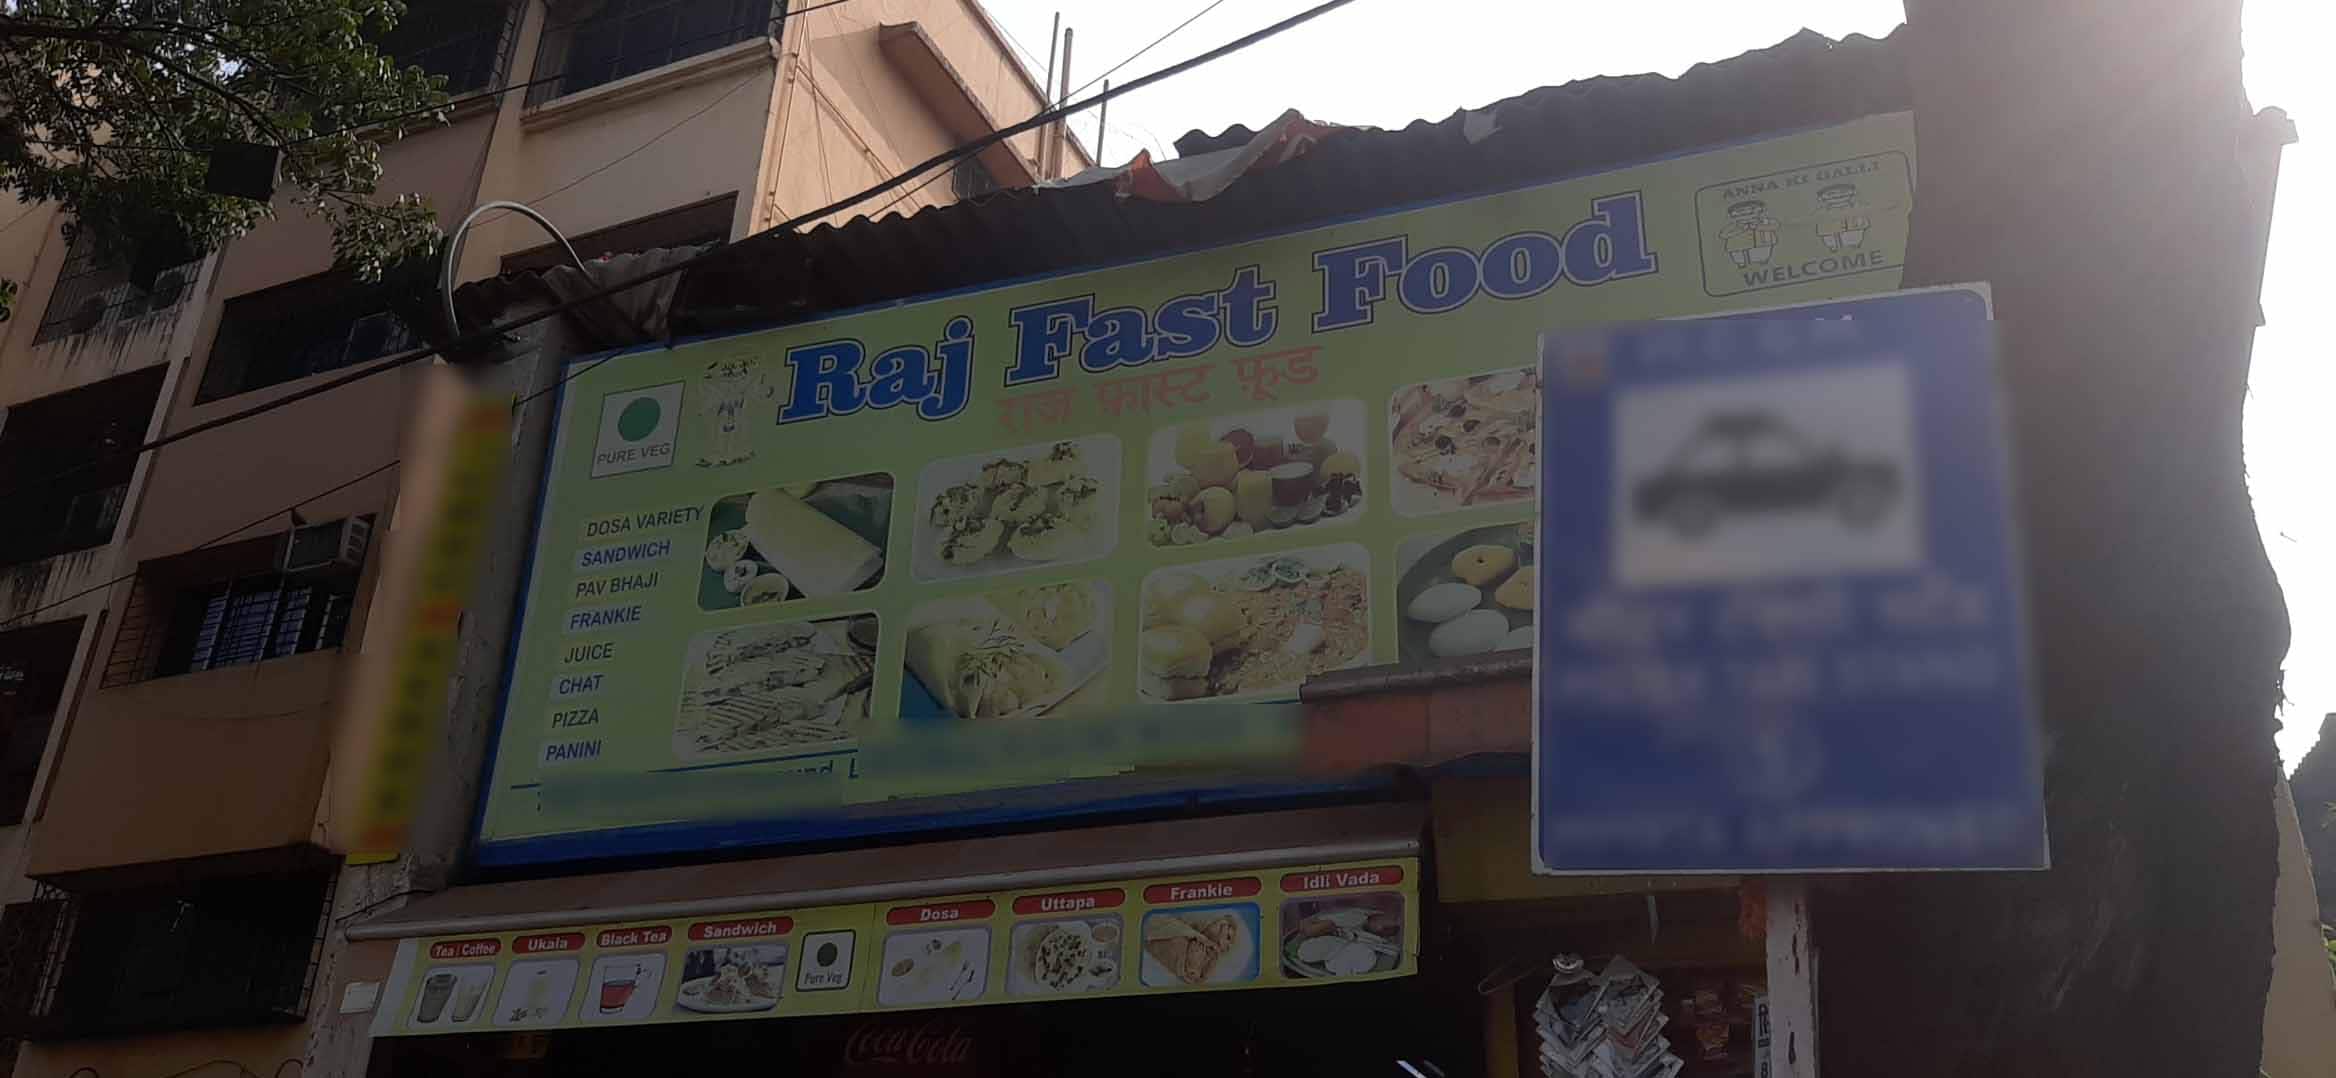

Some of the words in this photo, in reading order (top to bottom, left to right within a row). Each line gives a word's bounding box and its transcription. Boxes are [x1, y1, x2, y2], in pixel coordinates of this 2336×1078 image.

[1743, 250, 1885, 287] WELCOME
[778, 317, 975, 424] Raj
[1004, 265, 1278, 389] Fast
[1311, 190, 1659, 334] Food
[596, 448, 637, 466] PURE
[638, 442, 672, 460] VEG
[586, 518, 632, 538] DOSA
[636, 505, 706, 530] VARIETY
[580, 540, 672, 567] SANDWICH
[575, 580, 606, 599] PAV
[609, 571, 659, 594] BHAJI
[569, 605, 642, 631] FRANKIE
[563, 642, 615, 665] JUICE
[558, 674, 604, 695] CHAT
[551, 708, 600, 729] PIZZA
[545, 740, 602, 761] PANINI
[1302, 873, 1331, 890] Idli
[1335, 870, 1381, 888] Vada
[1169, 884, 1234, 901] Frankie
[1040, 895, 1096, 912] Uttapa
[919, 908, 960, 922] Dosa
[601, 931, 638, 947] Black
[641, 930, 668, 944] Tea
[703, 920, 777, 938] Sandwich
[435, 944, 455, 958] Tea
[462, 943, 497, 956] Coffee
[527, 936, 569, 952] Ukala
